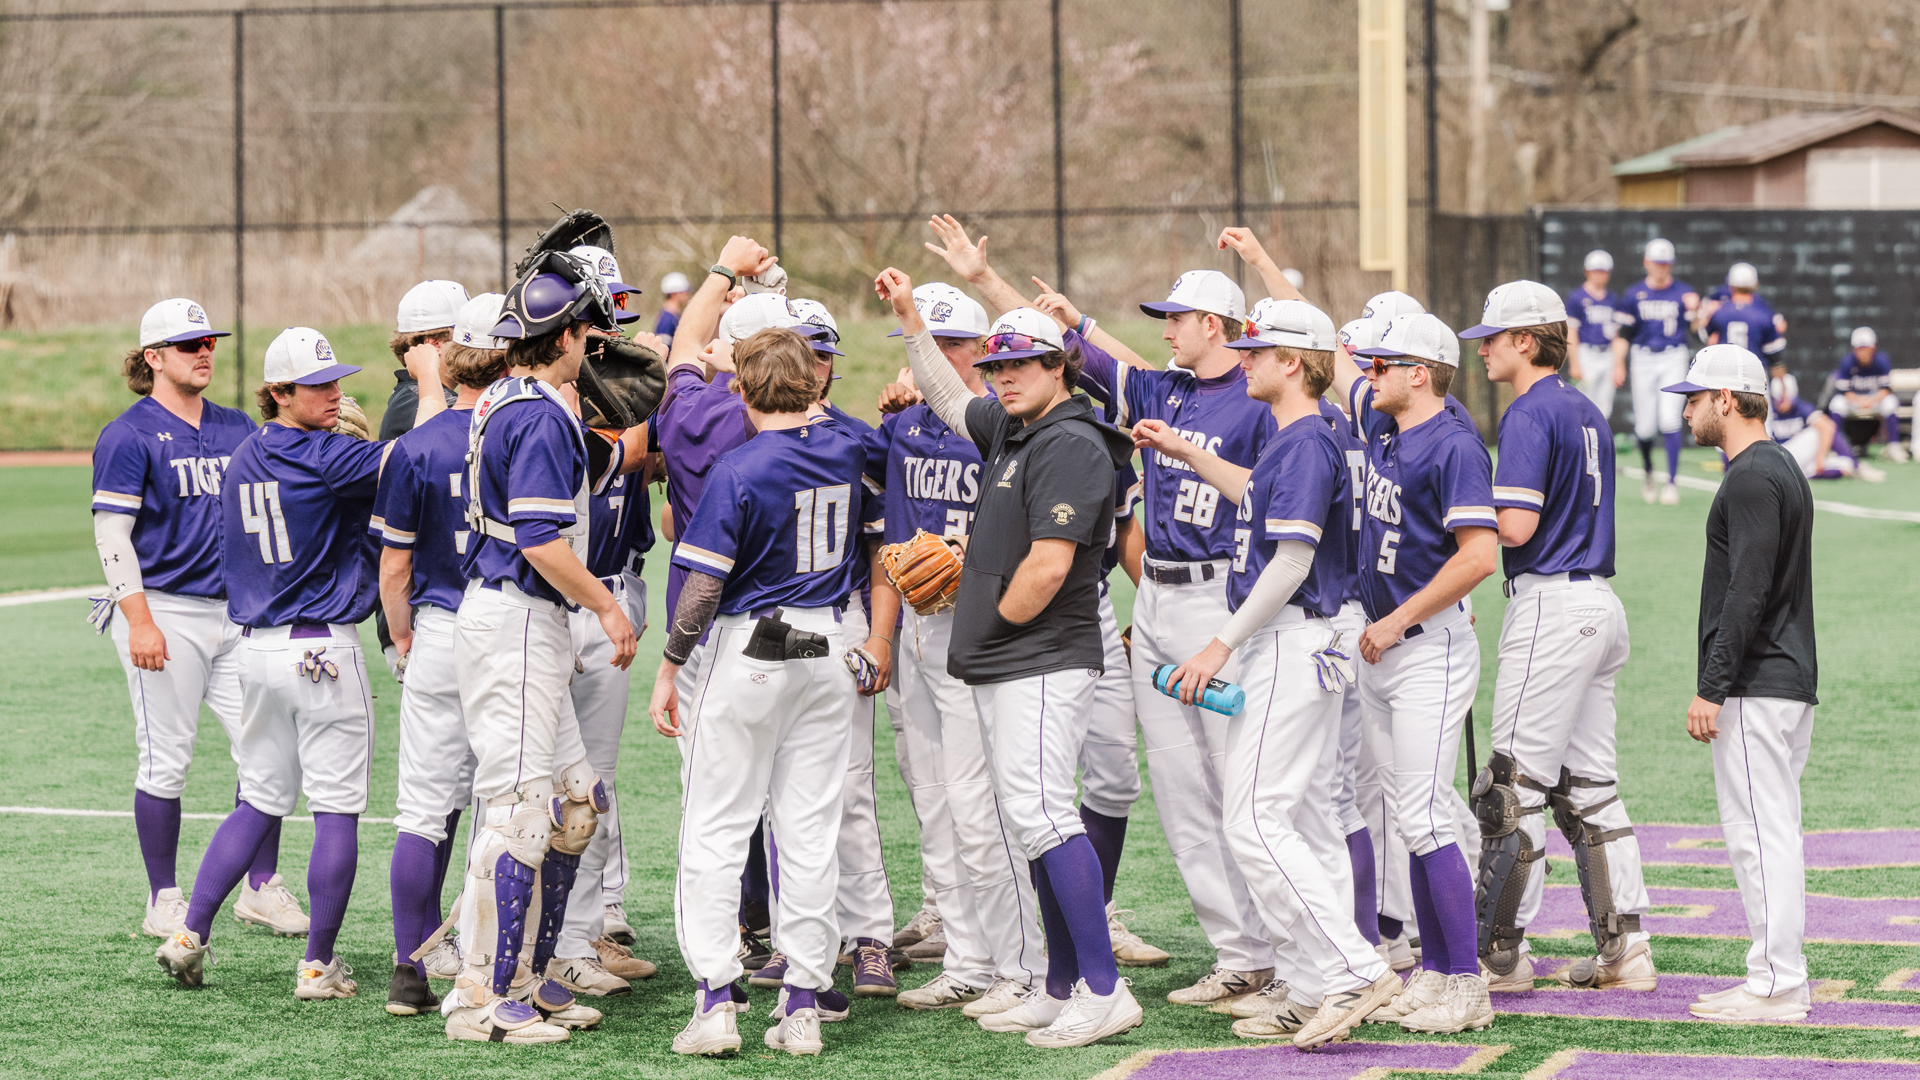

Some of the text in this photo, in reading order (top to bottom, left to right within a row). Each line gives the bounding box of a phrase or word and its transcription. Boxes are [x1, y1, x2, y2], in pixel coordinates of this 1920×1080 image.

[904, 456, 980, 504] TIGERS
[1581, 426, 1602, 507] 4
[238, 481, 293, 565] 41
[608, 495, 625, 538] 7
[944, 508, 976, 537] 2
[1174, 479, 1221, 528] 28
[795, 483, 851, 573] 10
[1232, 528, 1253, 573] 3
[1377, 530, 1401, 575] 5
